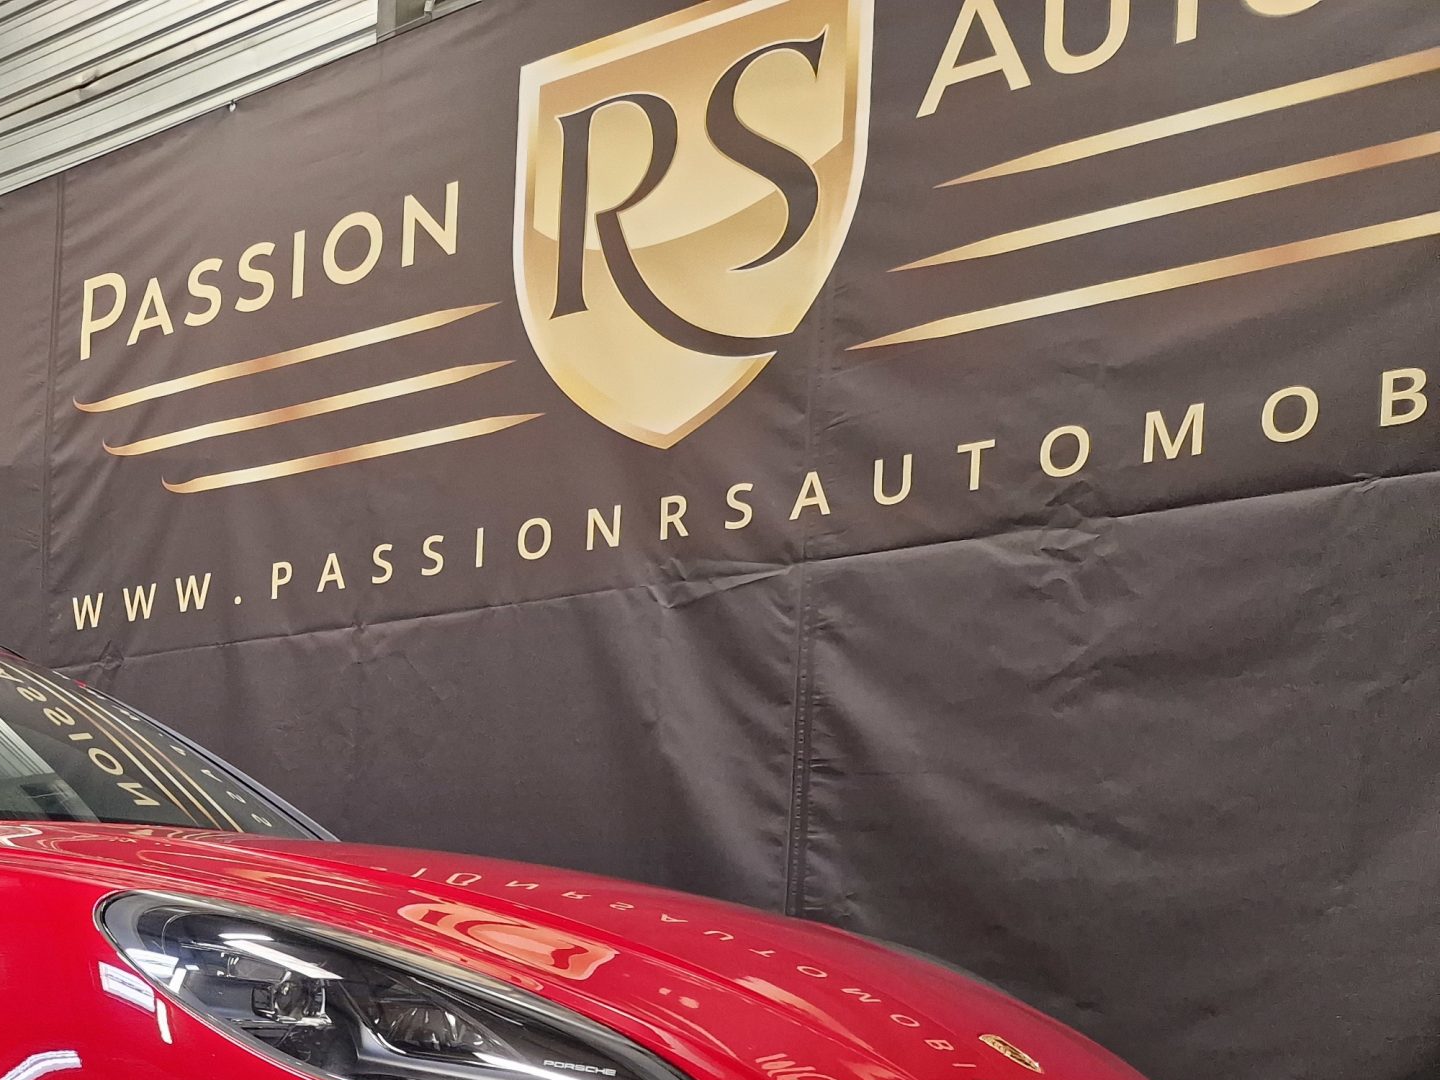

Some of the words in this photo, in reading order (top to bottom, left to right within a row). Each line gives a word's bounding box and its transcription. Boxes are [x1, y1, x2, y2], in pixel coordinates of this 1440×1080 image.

[79, 180, 460, 361] PASSION
[548, 22, 829, 358] RS
[543, 1059, 617, 1077] PORSCHE
